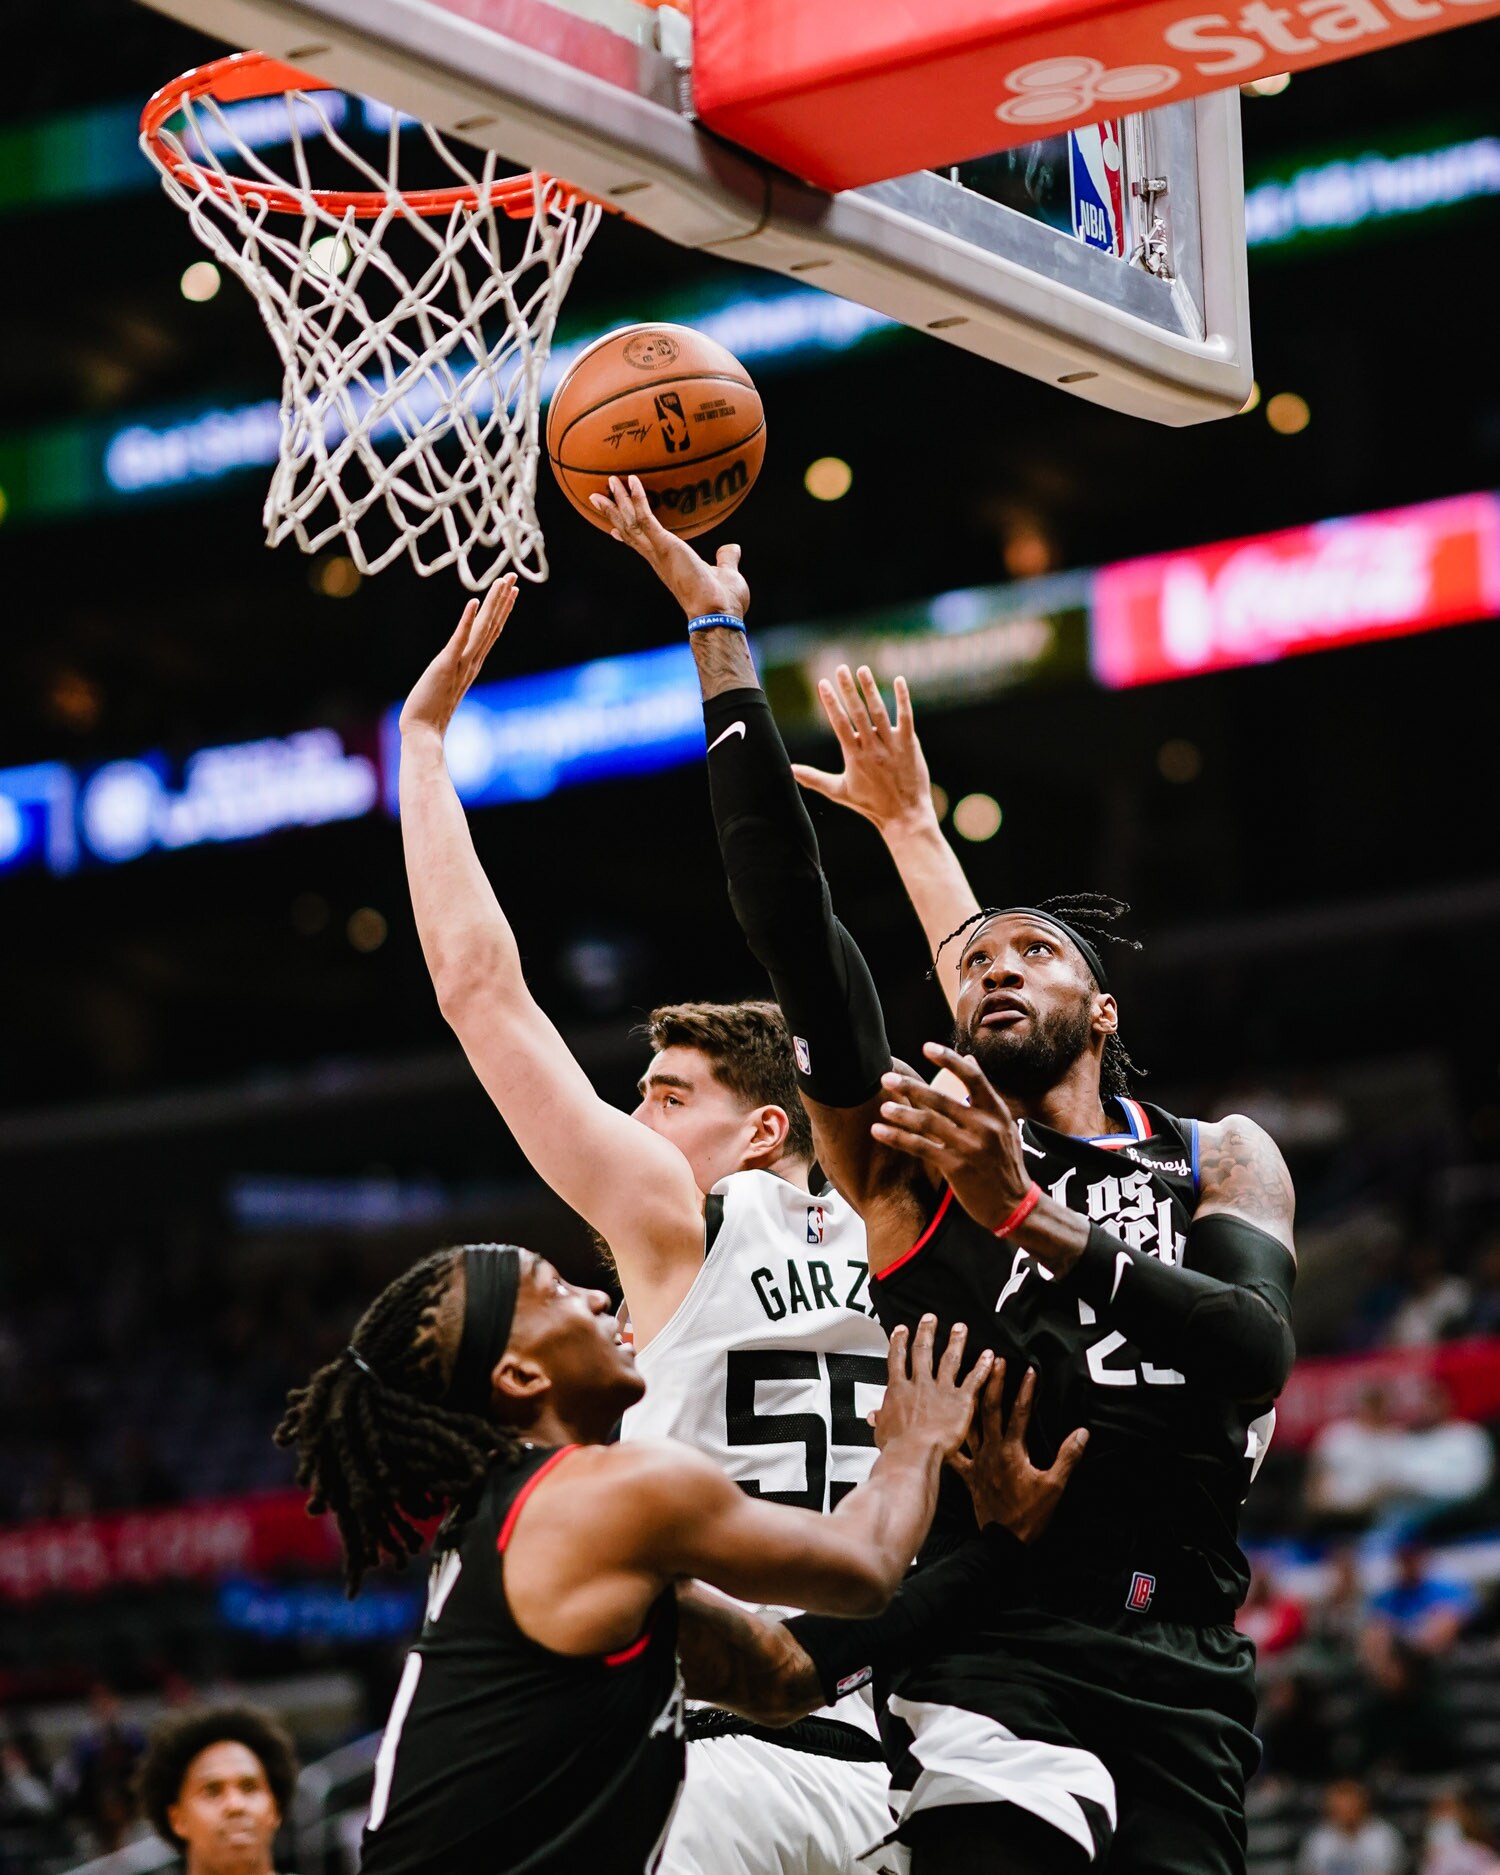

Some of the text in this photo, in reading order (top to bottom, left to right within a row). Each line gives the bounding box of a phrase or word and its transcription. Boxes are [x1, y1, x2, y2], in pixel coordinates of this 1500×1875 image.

[1080, 199, 1108, 244] NBA
[699, 616, 724, 625] NAME
[1126, 1147, 1192, 1177] honey
[1048, 1167, 1156, 1221] Los
[751, 1259, 880, 1321] GARZ
